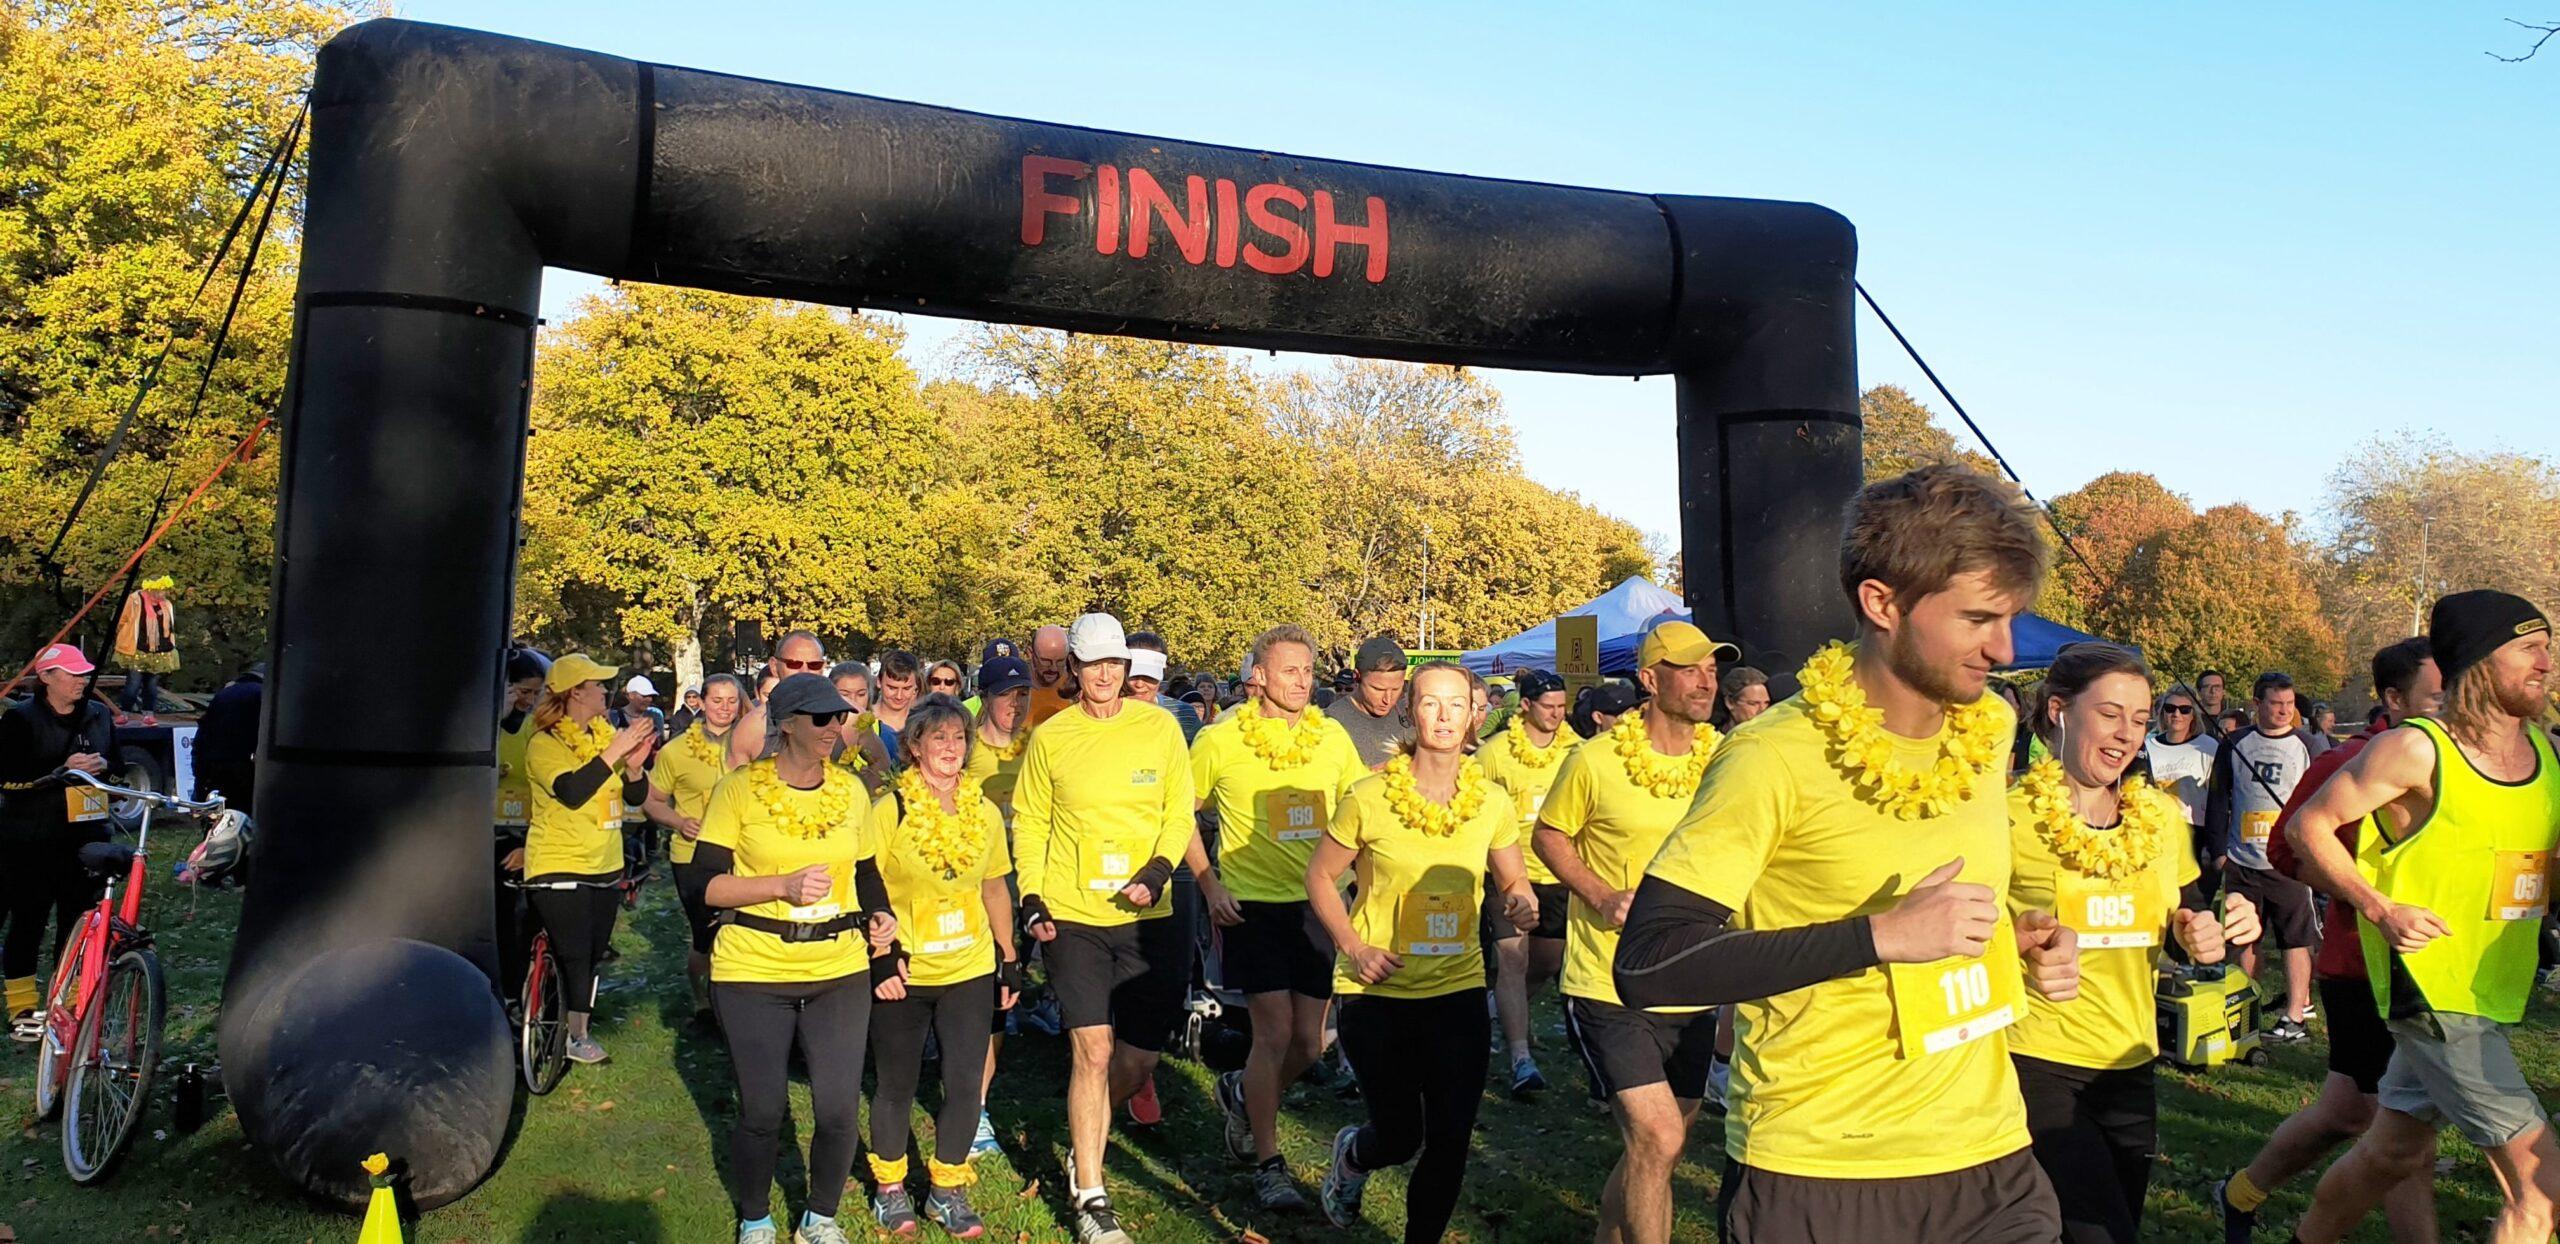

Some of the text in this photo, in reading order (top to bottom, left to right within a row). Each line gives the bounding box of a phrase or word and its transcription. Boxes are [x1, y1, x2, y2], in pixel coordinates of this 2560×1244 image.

[1021, 154, 1391, 283] FINISH
[1563, 663, 1591, 673] ZONTA
[2086, 894, 2136, 927] 095
[1938, 962, 1991, 1016] 110
